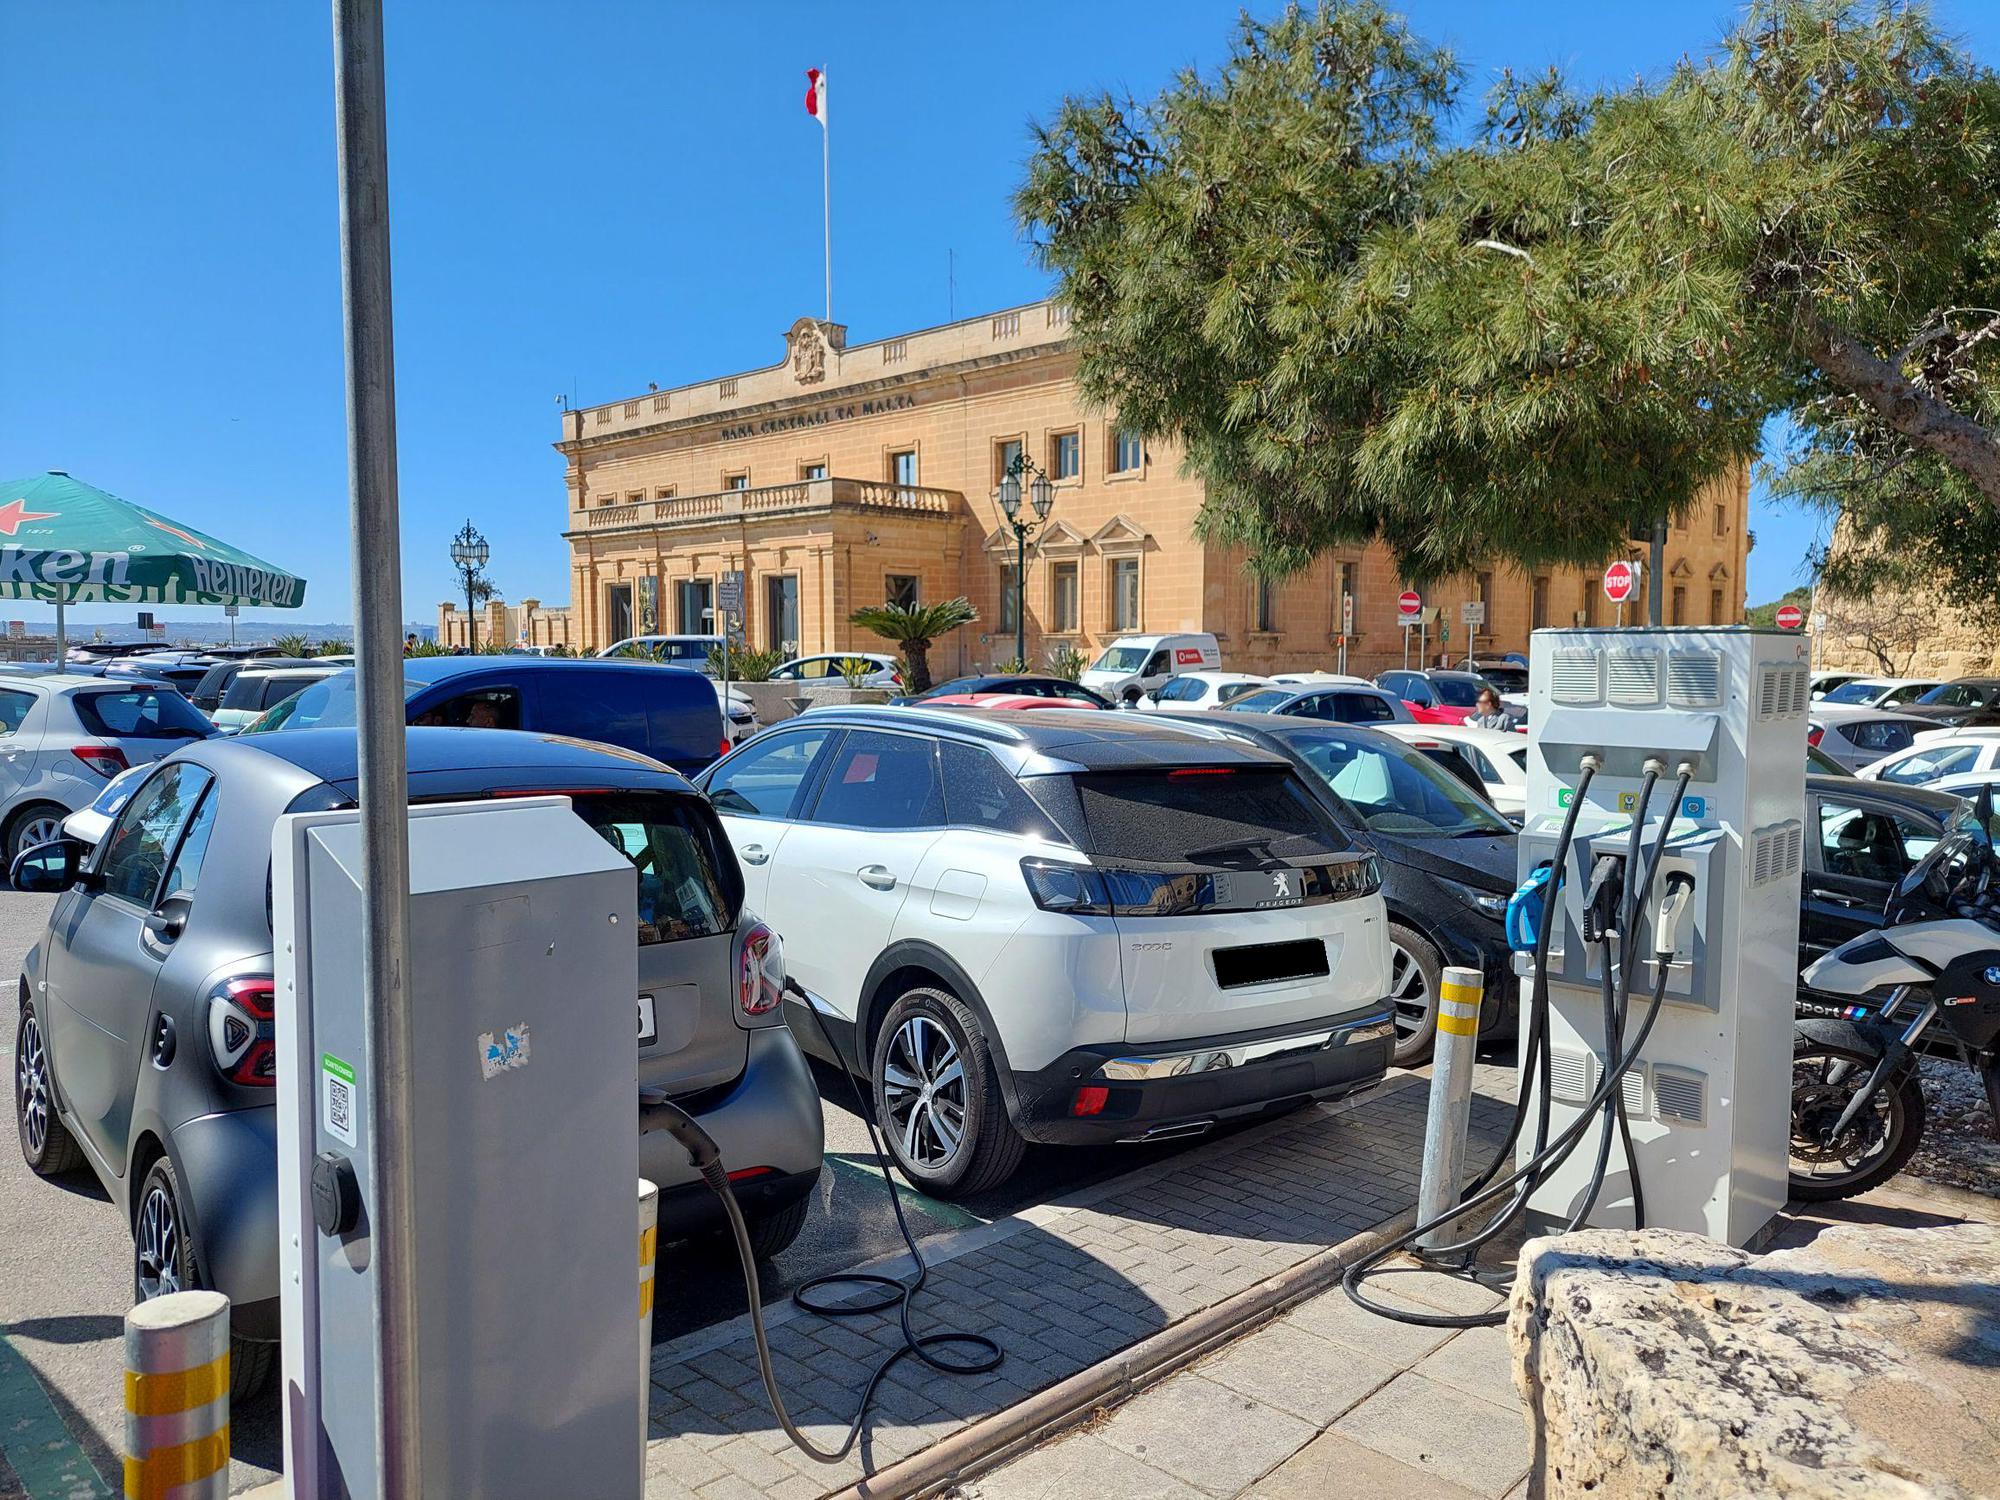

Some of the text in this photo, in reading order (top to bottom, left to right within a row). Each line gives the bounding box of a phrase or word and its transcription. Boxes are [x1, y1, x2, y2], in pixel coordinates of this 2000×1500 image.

[186, 553, 297, 606] Heineken
[1607, 575, 1630, 588] STOP
[1259, 898, 1303, 907] PEUGEOT
